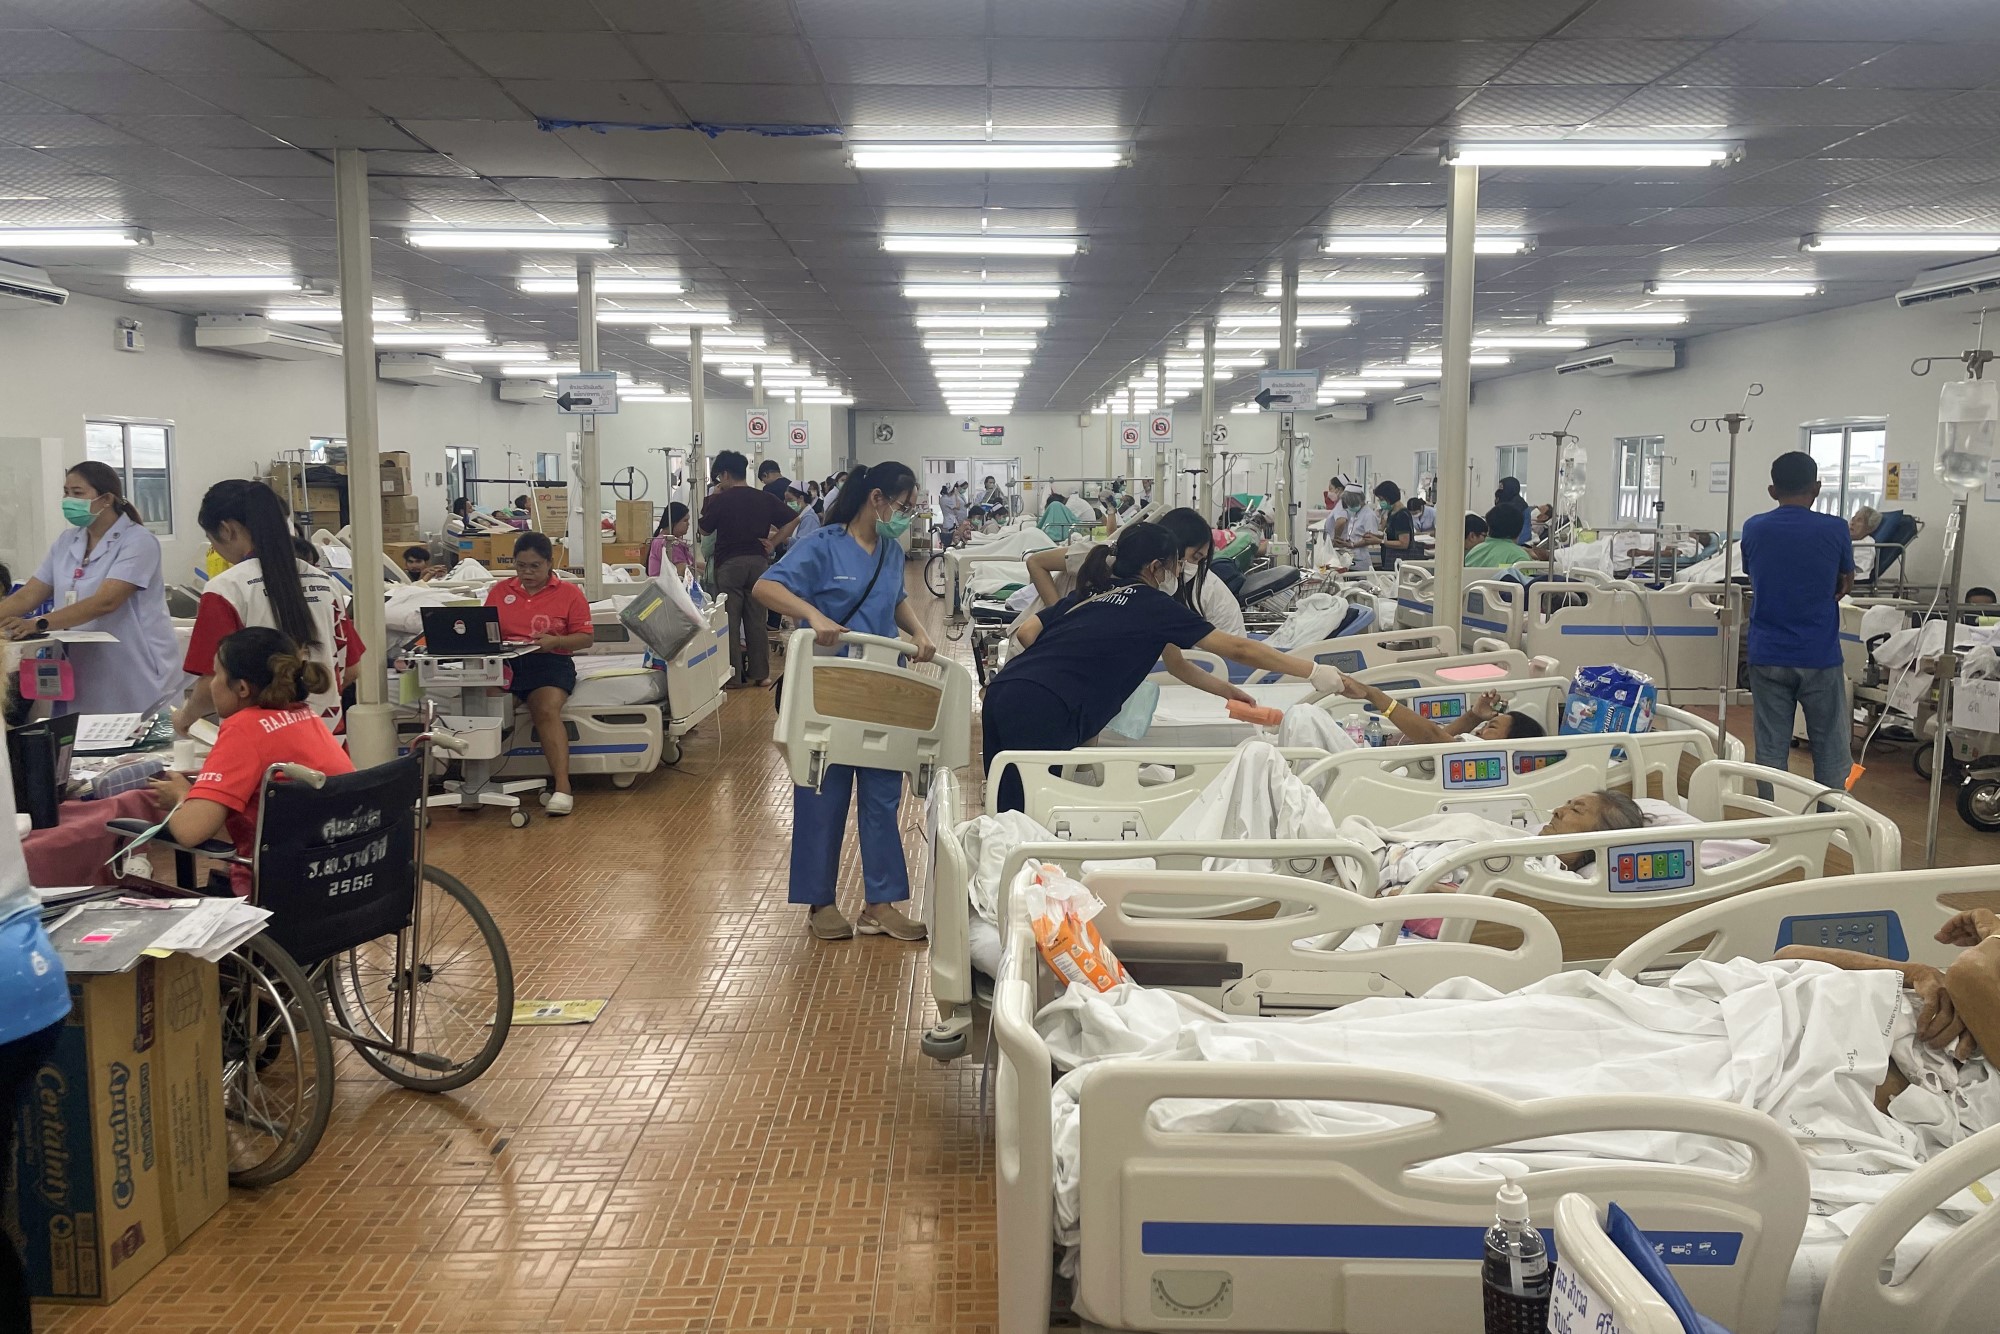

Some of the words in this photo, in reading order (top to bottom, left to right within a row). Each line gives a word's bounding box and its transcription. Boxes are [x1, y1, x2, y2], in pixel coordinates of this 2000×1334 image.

[1600, 704, 1616, 733] ertainty
[329, 873, 373, 896] 2566
[109, 1062, 135, 1210] Certainty
